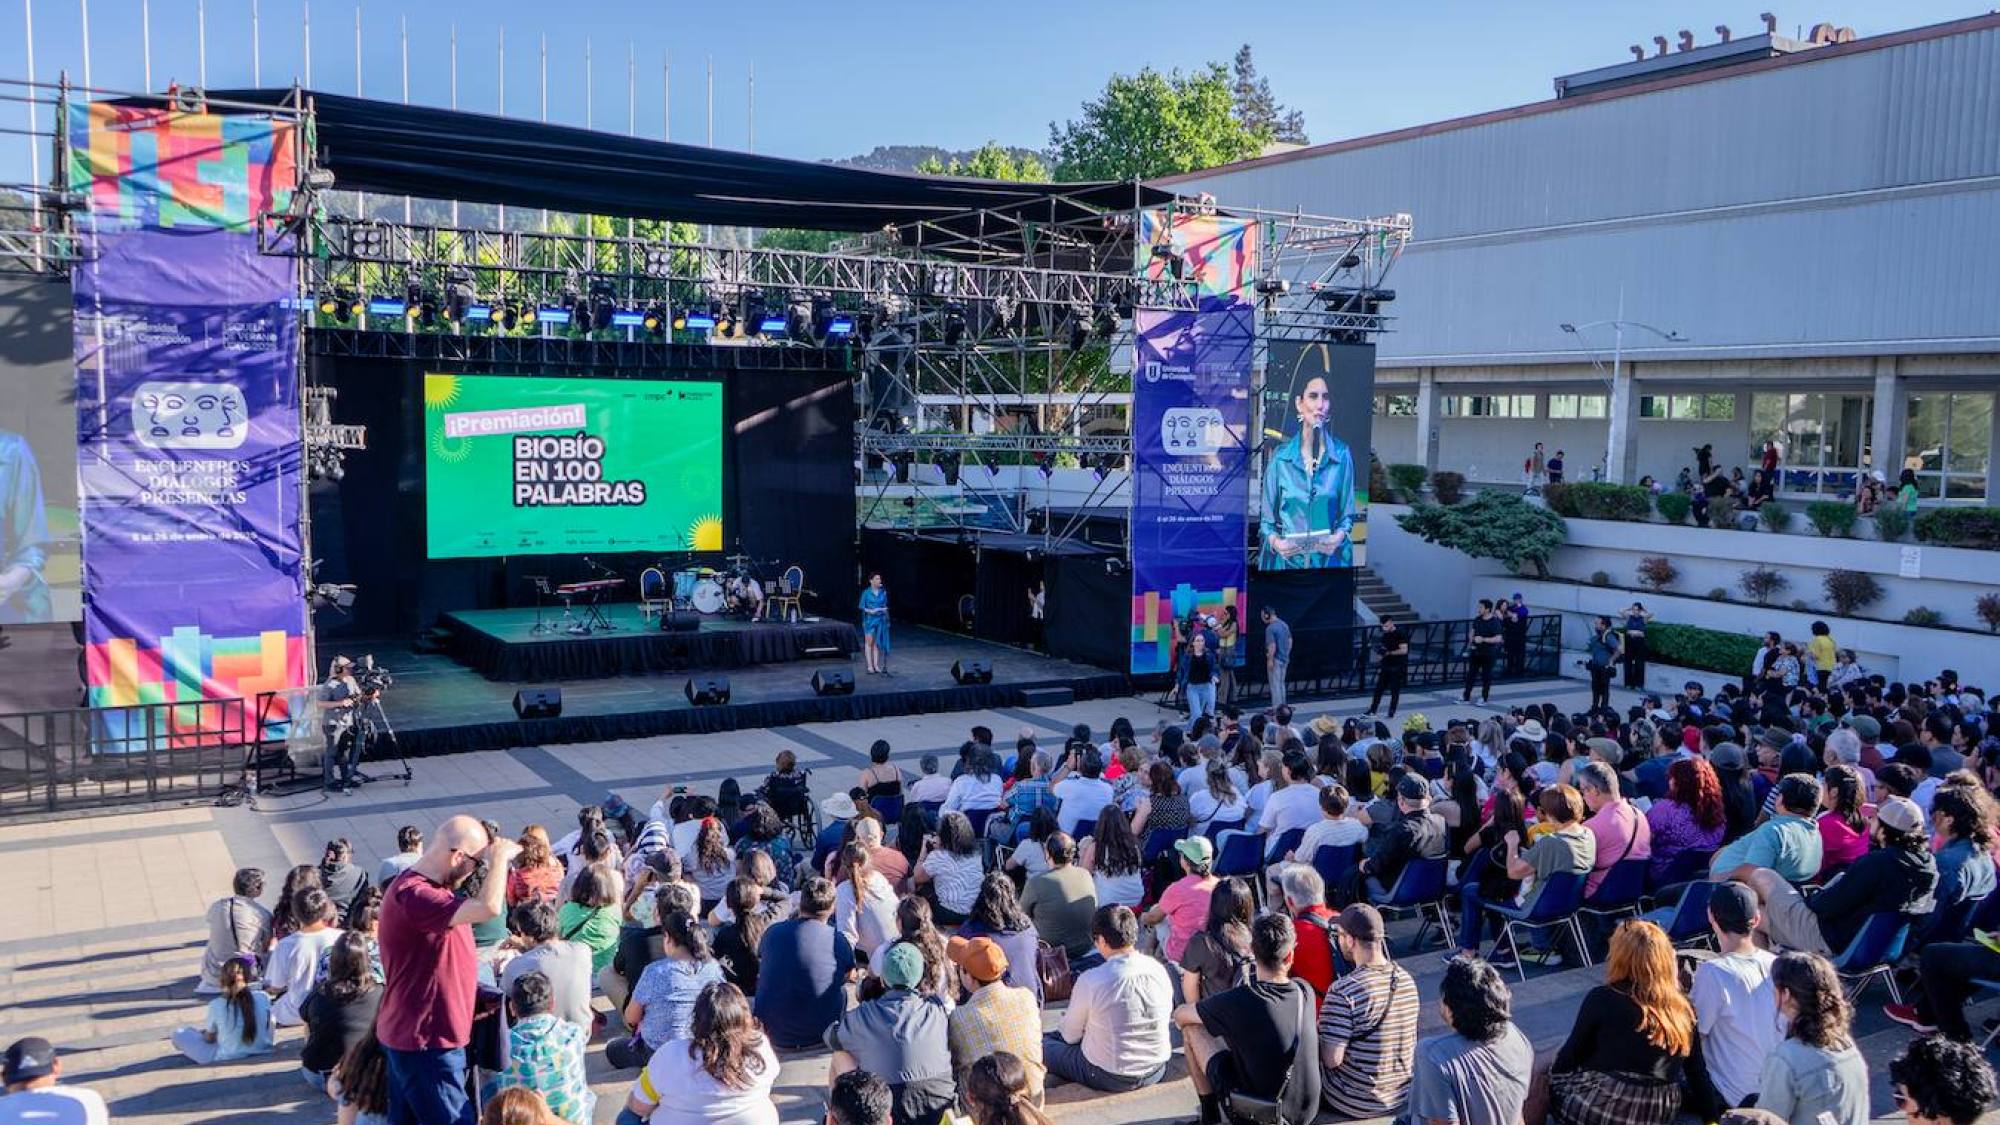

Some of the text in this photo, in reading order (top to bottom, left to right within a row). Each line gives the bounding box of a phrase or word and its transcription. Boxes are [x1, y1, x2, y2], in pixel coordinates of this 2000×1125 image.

[450, 407, 581, 435] ¡Premiación!
[514, 432, 604, 459] BIOBÍO
[134, 460, 250, 473] ENCUENTROS
[515, 460, 601, 481] EN 100
[1162, 463, 1222, 474] ENCUENTROS
[1168, 473, 1215, 484] DIÁLOGOS
[514, 482, 645, 505] PALABRAS
[1165, 485, 1219, 496] PRESENCIAS
[141, 491, 247, 504] PRESENCIAS
